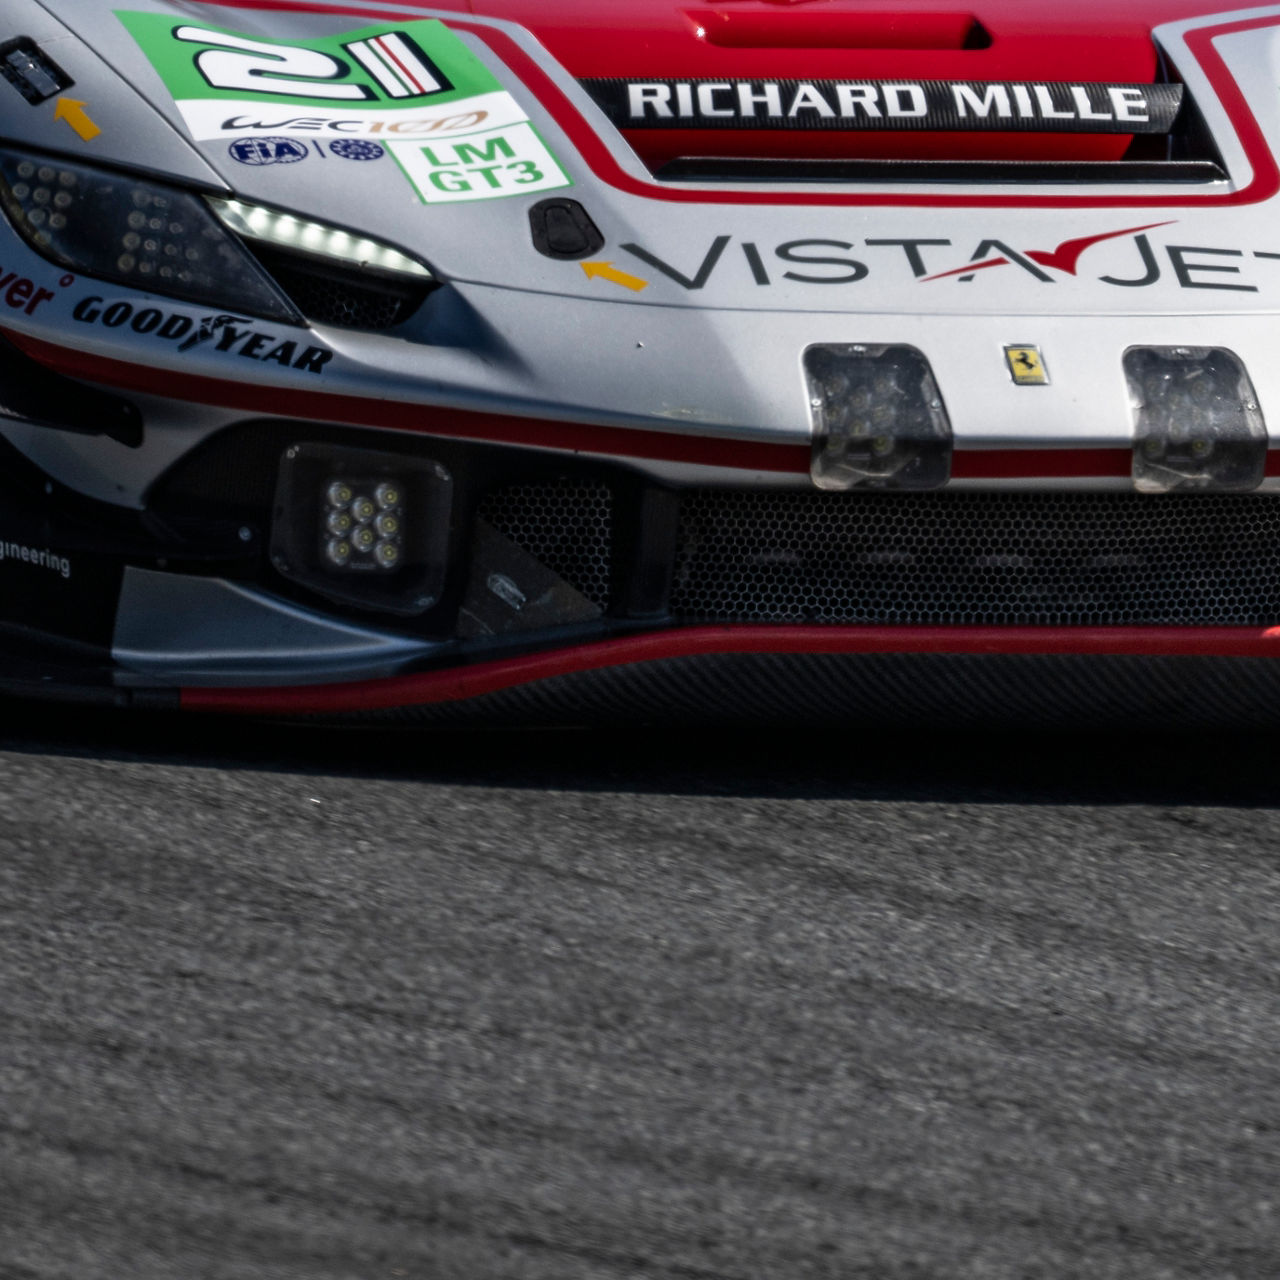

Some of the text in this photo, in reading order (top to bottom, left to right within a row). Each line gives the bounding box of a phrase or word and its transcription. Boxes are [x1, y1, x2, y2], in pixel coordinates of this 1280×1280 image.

[171, 25, 456, 102] 21
[627, 83, 1150, 122] RICHARD MILLE
[419, 136, 517, 167] LM
[428, 160, 546, 193] GT3
[72, 296, 334, 374] GOODYEAR
